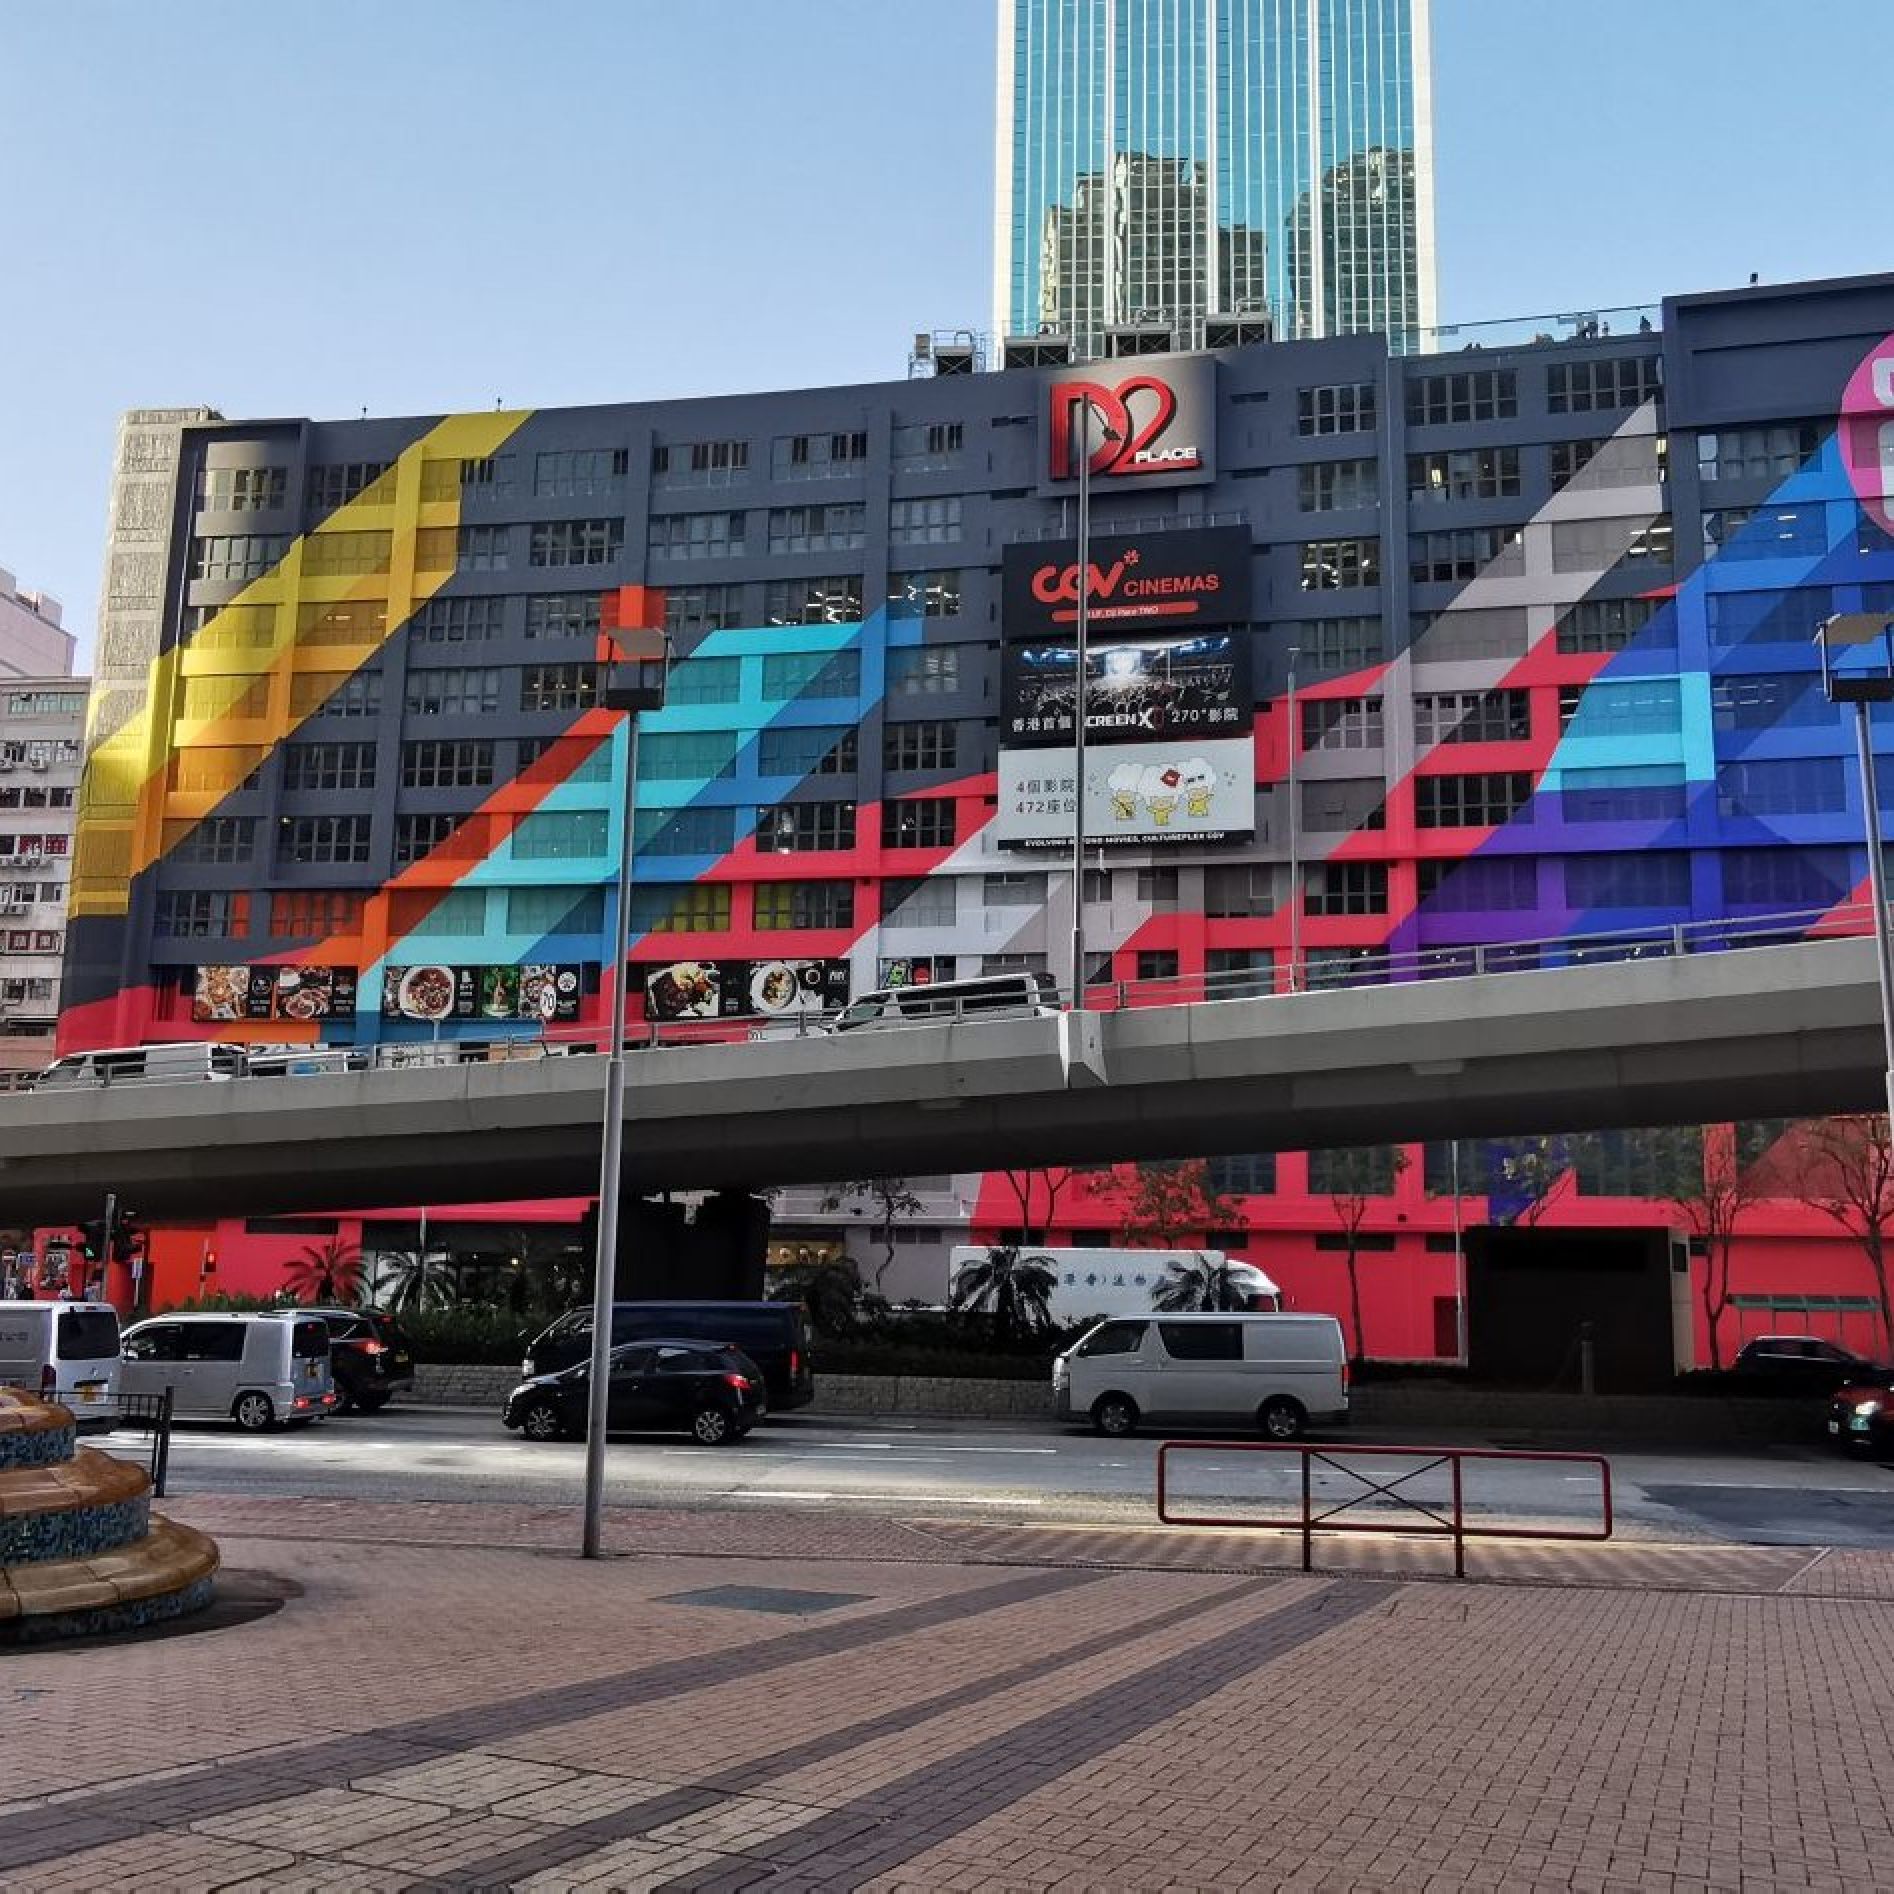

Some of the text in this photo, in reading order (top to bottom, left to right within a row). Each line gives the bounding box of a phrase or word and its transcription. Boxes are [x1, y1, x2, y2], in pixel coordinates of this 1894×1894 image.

[1050, 375, 1202, 481] D2
[1135, 447, 1198, 464] PLACE
[1123, 573, 1219, 596] CINEMAS
